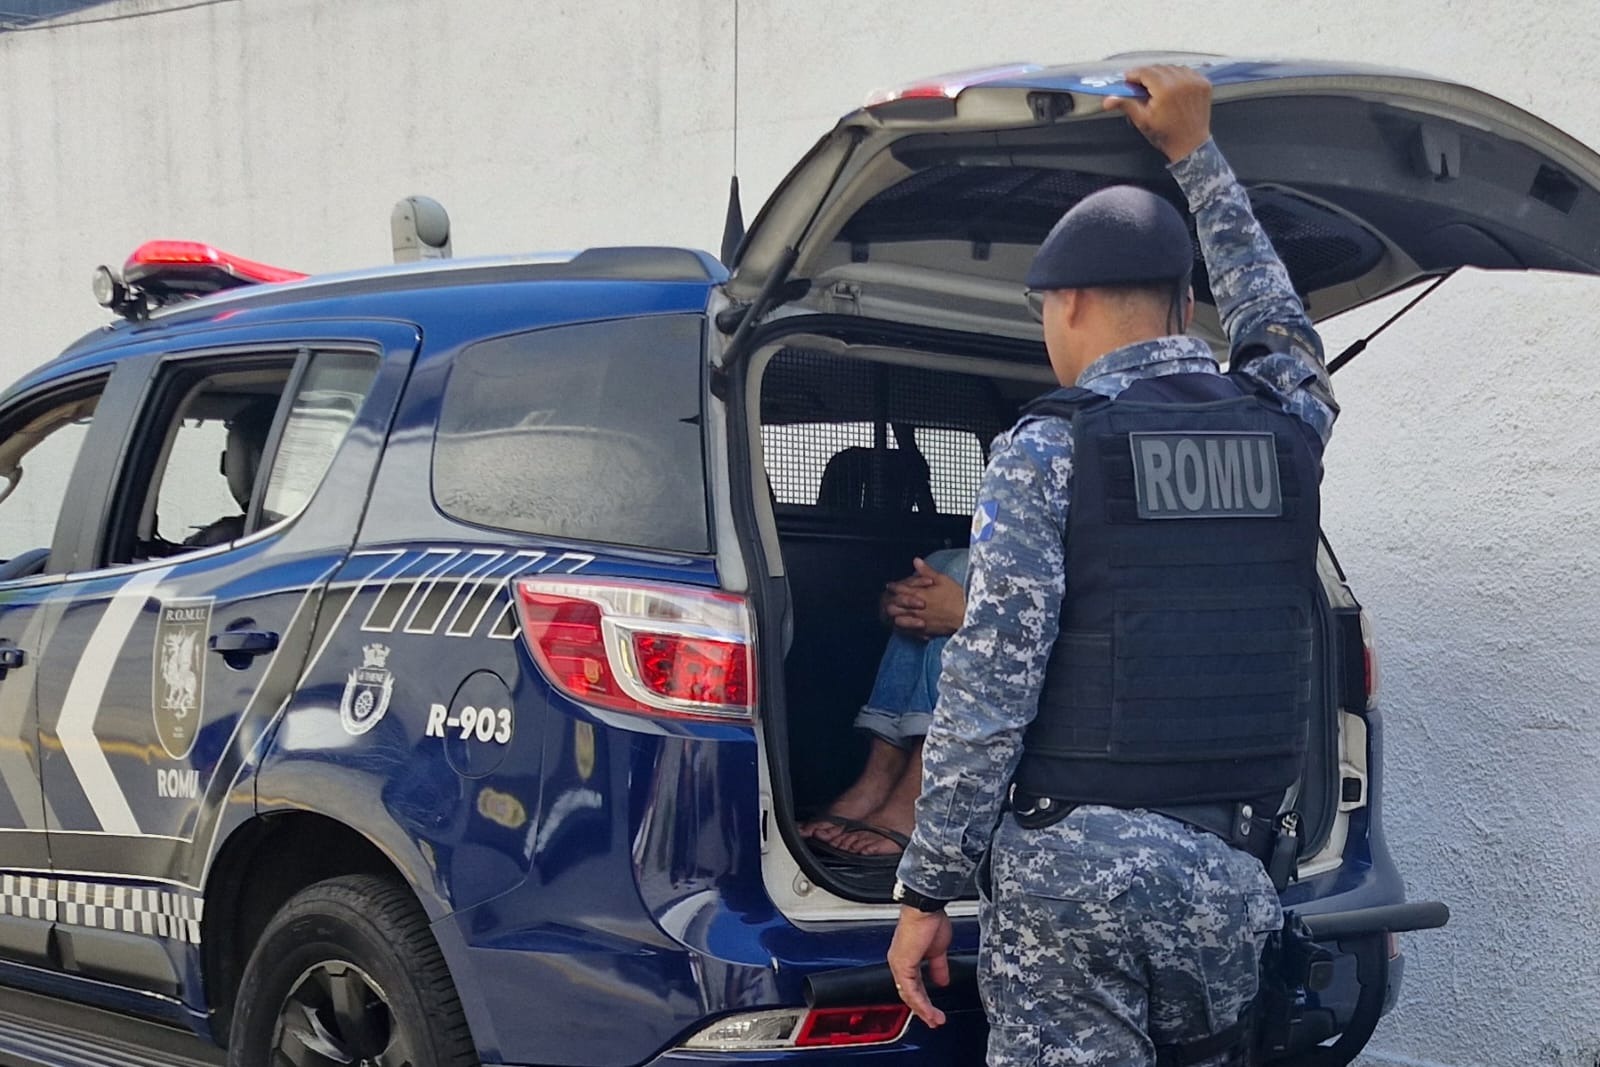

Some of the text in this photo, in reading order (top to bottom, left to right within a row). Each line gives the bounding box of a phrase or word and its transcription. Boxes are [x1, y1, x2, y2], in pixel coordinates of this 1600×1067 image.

[1141, 438, 1271, 511] ROMU
[425, 703, 511, 743] R-903
[157, 768, 199, 798] ROMU
